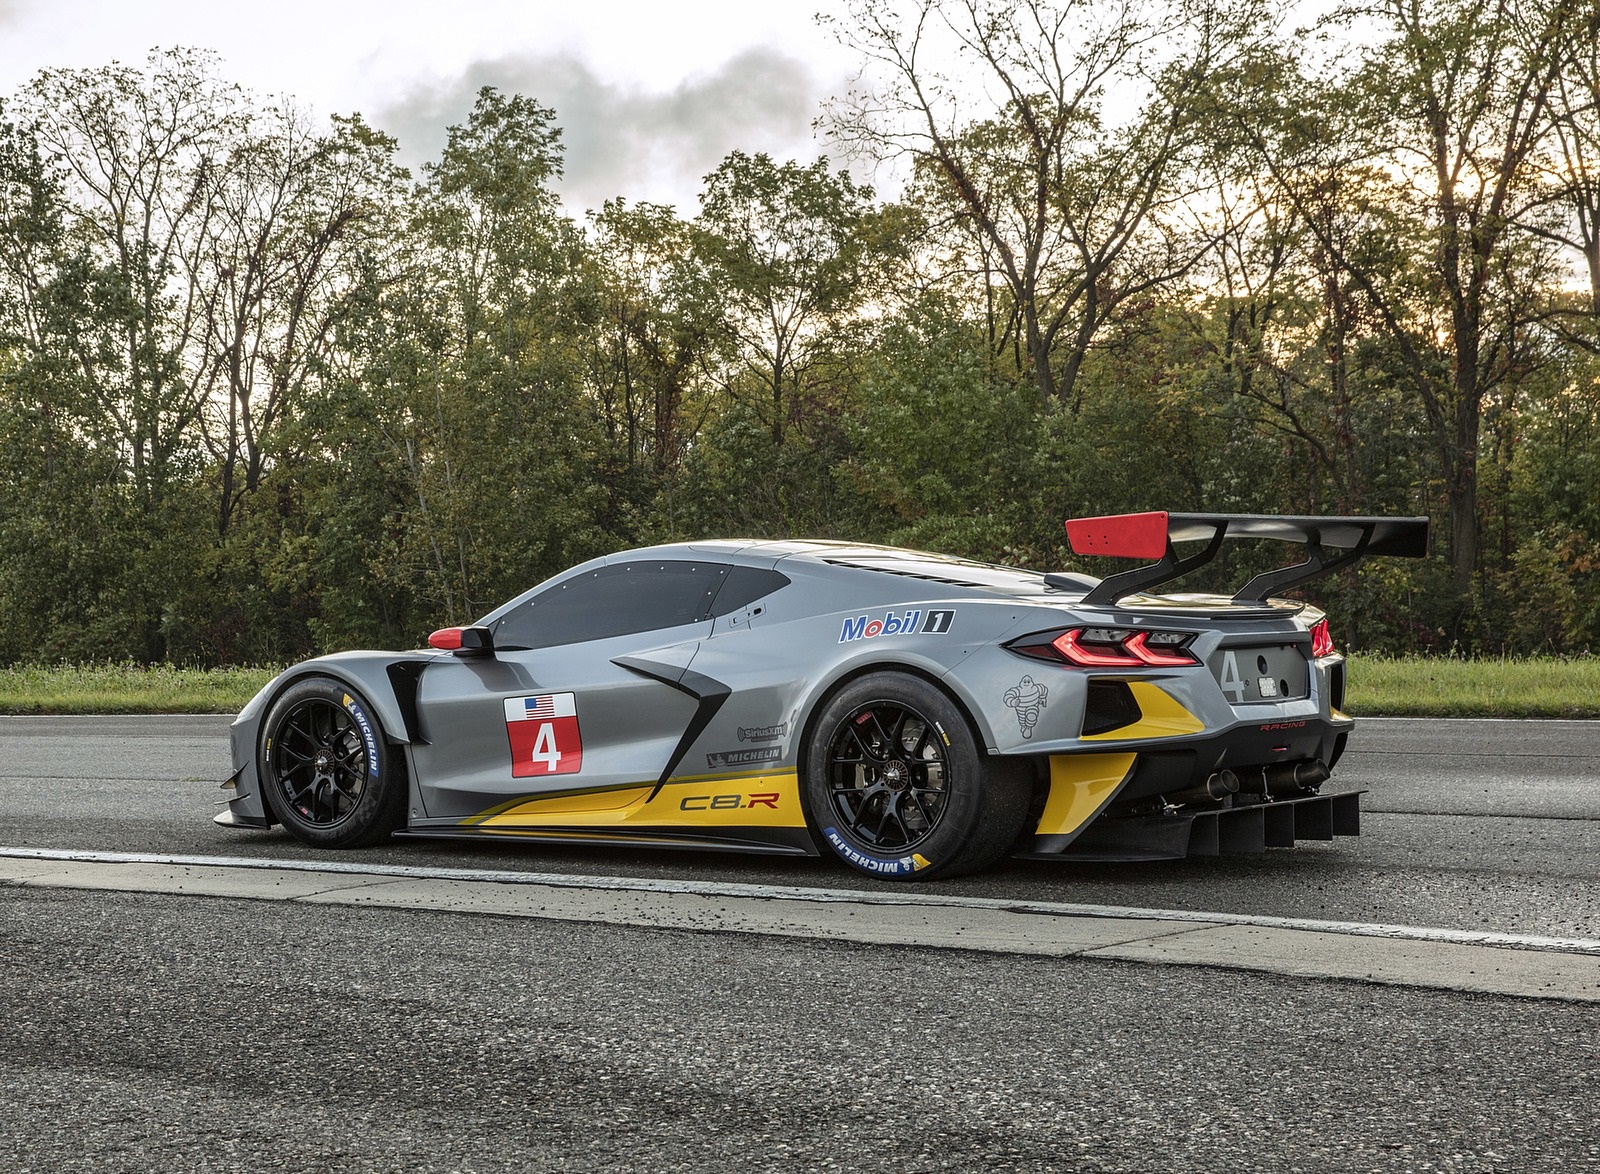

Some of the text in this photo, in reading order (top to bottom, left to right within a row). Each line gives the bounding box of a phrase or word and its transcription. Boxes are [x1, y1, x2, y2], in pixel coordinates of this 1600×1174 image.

[838, 610, 921, 643] Mobil
[1220, 650, 1245, 702] 4
[355, 711, 378, 771] MICHELIN
[1260, 721, 1307, 731] RACING
[532, 722, 562, 772] 4
[727, 748, 780, 762] MICHELIN
[680, 793, 780, 811] C8.R
[828, 833, 899, 873] MICHELIN
